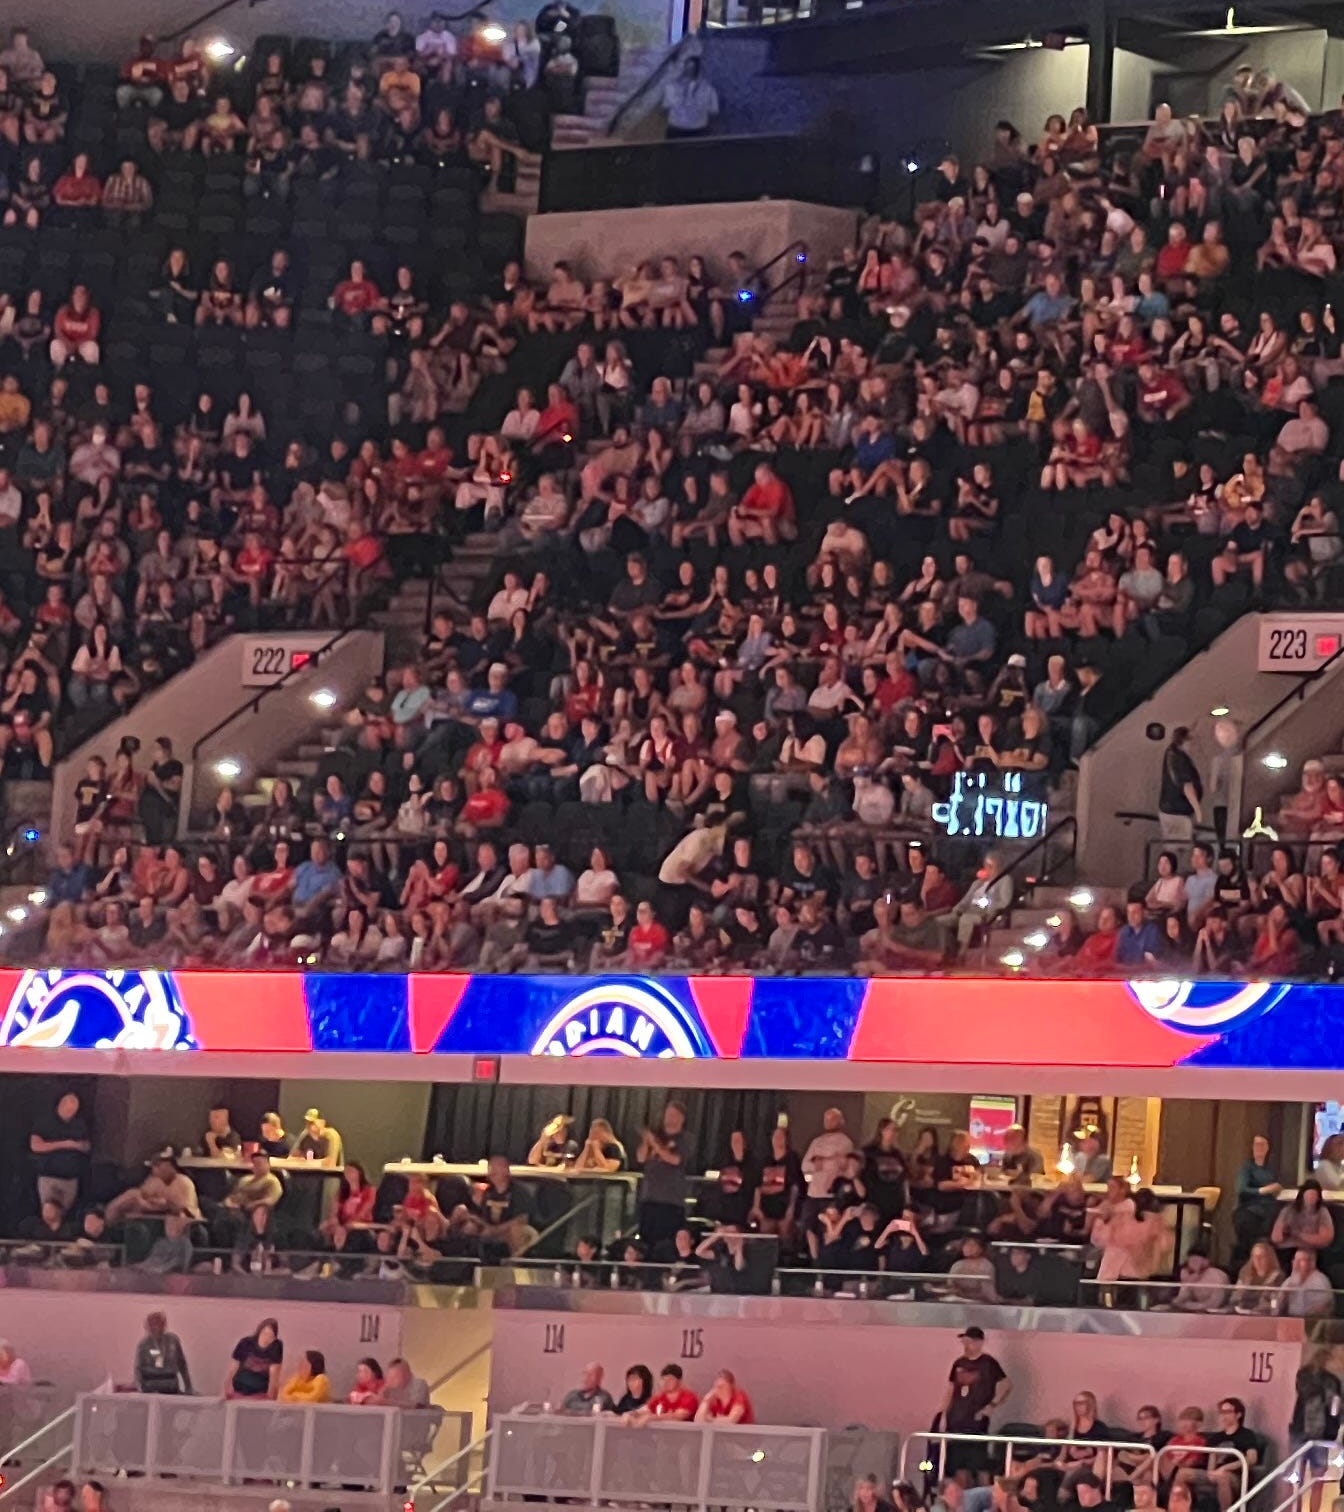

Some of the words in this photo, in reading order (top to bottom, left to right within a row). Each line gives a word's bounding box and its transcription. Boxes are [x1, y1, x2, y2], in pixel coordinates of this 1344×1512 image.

[1269, 629, 1307, 660] 223
[252, 647, 285, 675] 222
[360, 1314, 379, 1343] 114
[544, 1324, 565, 1354] 114
[681, 1328, 704, 1358] 115
[1249, 1352, 1275, 1383] 115
